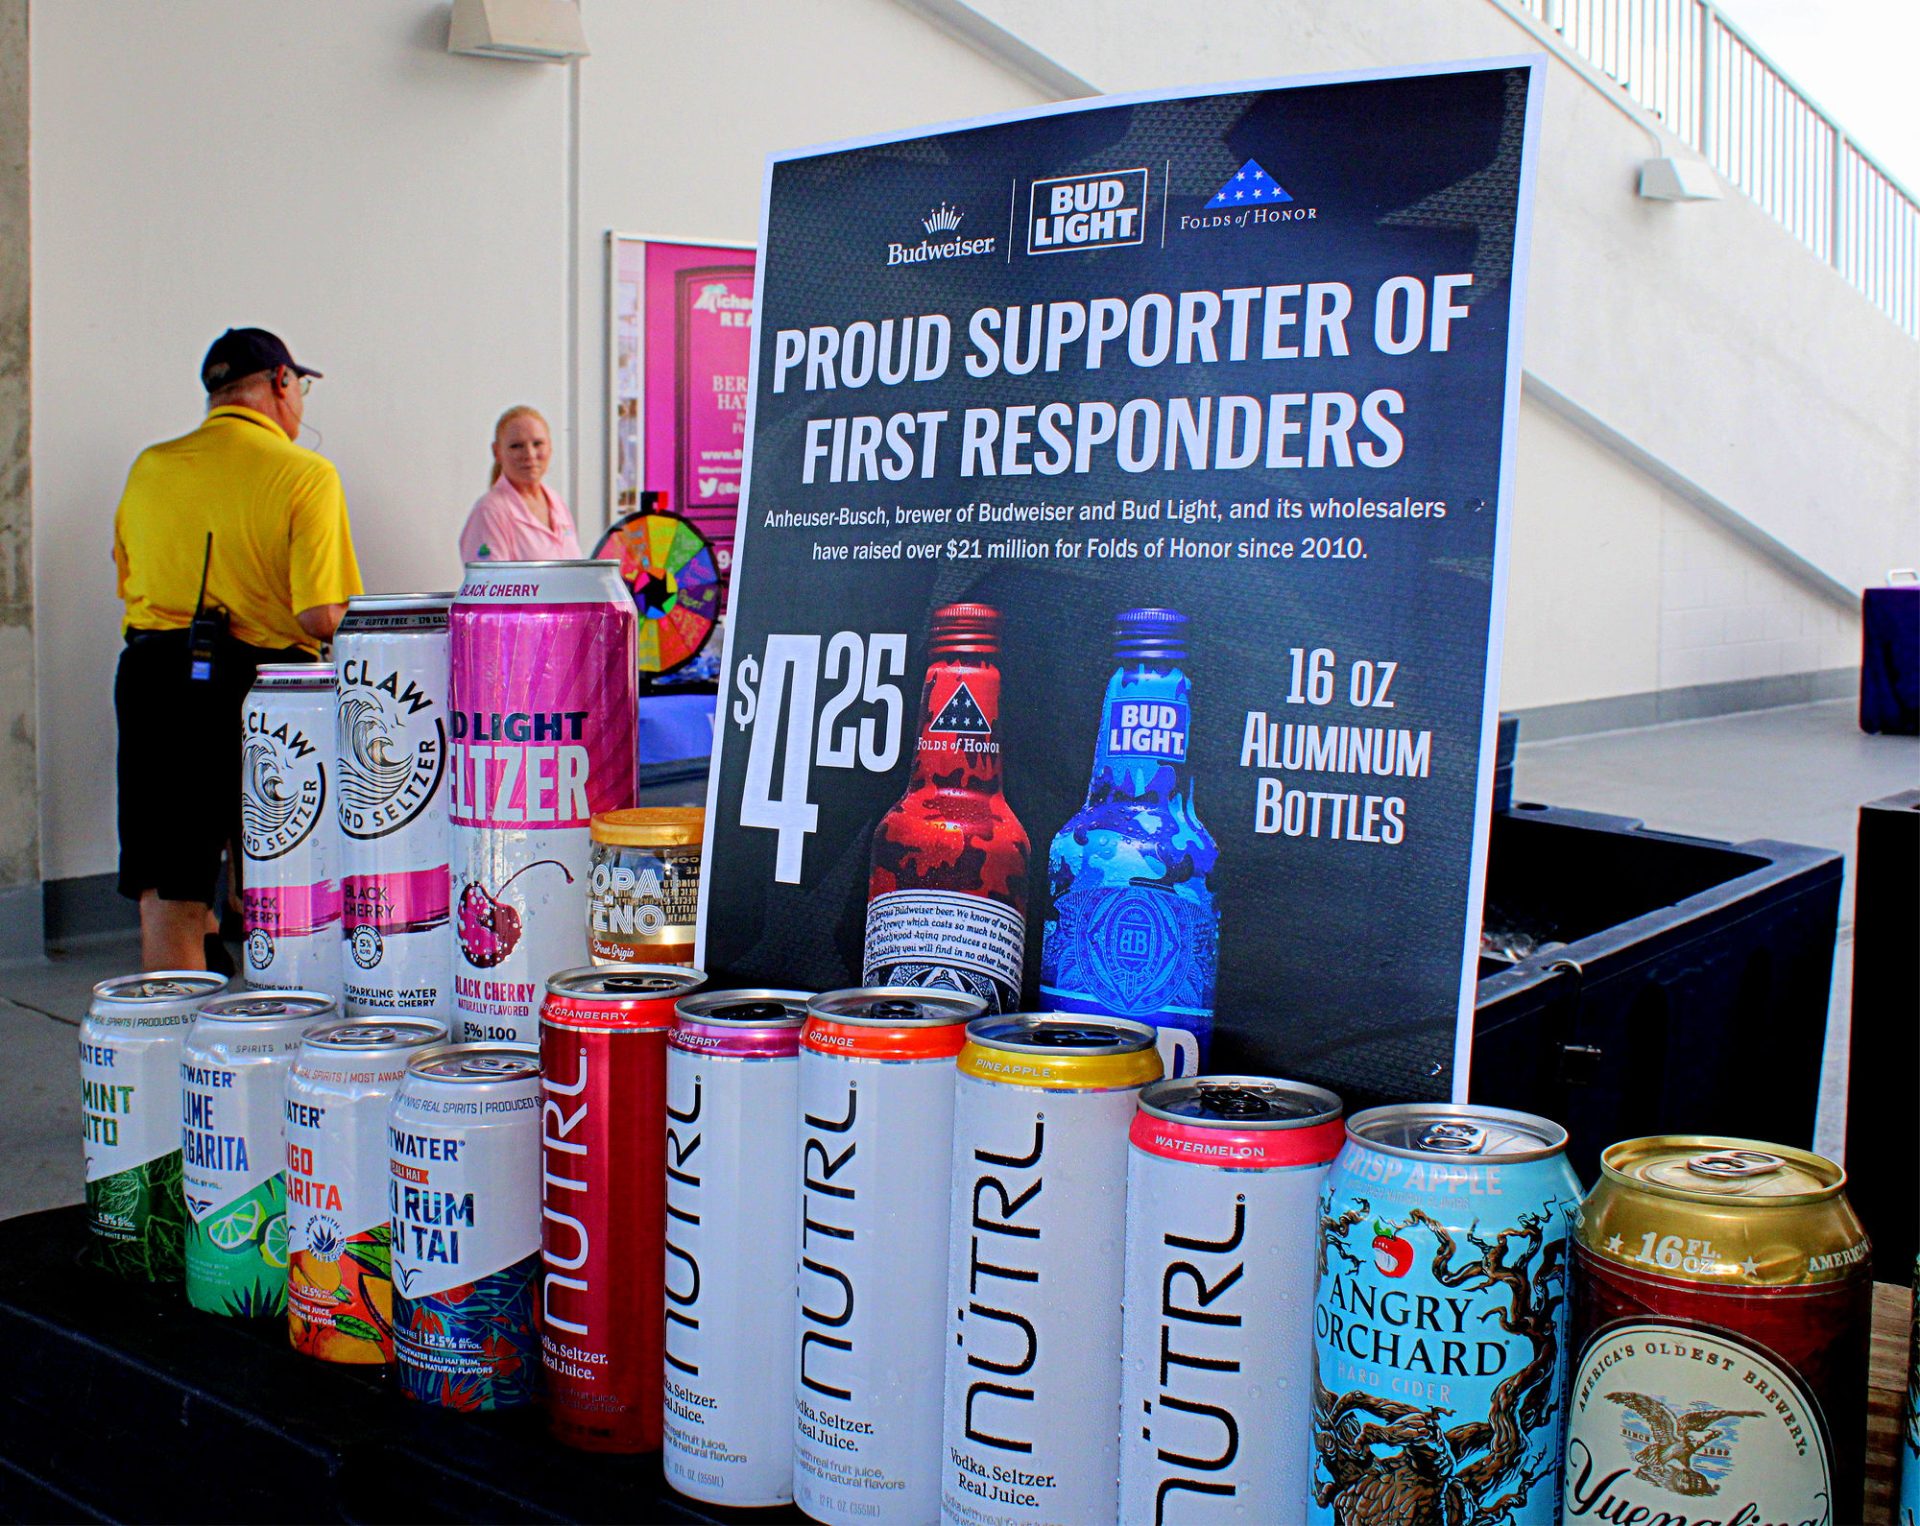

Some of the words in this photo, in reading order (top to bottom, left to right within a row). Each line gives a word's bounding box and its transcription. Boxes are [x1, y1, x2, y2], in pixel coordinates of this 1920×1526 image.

[1050, 180, 1124, 215] BUD
[1034, 208, 1137, 247] LIGHT
[1180, 214, 1231, 230] FOLDS
[1235, 210, 1249, 227] of
[1253, 207, 1318, 224] HONOR
[886, 236, 995, 266] Budweiser
[773, 314, 951, 394] PROUD
[965, 282, 1352, 379] SUPPORTER
[1374, 273, 1473, 355] OF
[802, 411, 948, 484] FIRST
[960, 389, 1405, 478] RESPONDERS
[764, 506, 890, 528] Anheuser-Busch,
[895, 505, 952, 524] brewer
[956, 503, 976, 523] of
[979, 501, 1073, 522] Budweiser
[1079, 500, 1115, 521] and
[1122, 500, 1160, 520] Bud
[1167, 499, 1223, 524] Light,
[1229, 498, 1269, 519] and
[1276, 497, 1303, 519] its
[1309, 497, 1447, 519] wholesalers
[812, 542, 848, 560] have
[853, 541, 901, 560] raised
[906, 543, 942, 559] over
[946, 539, 983, 560] $21
[987, 539, 1050, 558] million
[1054, 538, 1081, 558] for
[1087, 538, 1138, 558] Folds
[1143, 537, 1165, 558] of
[1170, 537, 1232, 558] Honor
[1237, 537, 1294, 558] since
[1300, 537, 1368, 559] 2010.
[490, 584, 539, 597] CHERRY
[344, 659, 433, 715] CLAW
[1286, 648, 1335, 706] 16
[474, 711, 589, 742] LIGHT
[1121, 704, 1177, 729] BUD
[249, 711, 316, 759] CLAW
[950, 738, 962, 754] of
[1110, 728, 1185, 755] LIGHT
[373, 740, 436, 827] SELTZER
[268, 780, 317, 850] SELTZER
[345, 885, 388, 901] BLACK
[344, 902, 395, 919] CHERRY
[894, 905, 934, 917] Budweiser
[935, 906, 955, 918] beer.
[957, 908, 969, 920] We
[970, 911, 991, 925] know
[906, 916, 929, 929] which
[932, 919, 953, 930] costs
[955, 922, 965, 931] so
[967, 924, 988, 938] much
[360, 938, 372, 948] 5%
[941, 934, 981, 949] produces
[902, 945, 916, 955] you
[918, 944, 934, 954] will
[935, 943, 953, 955] find
[964, 951, 976, 961] no
[977, 953, 997, 967] other
[349, 984, 394, 998] SPARKLING
[398, 988, 437, 999] WATER
[455, 975, 481, 999] BLACK
[484, 981, 536, 1003] CHERRY
[359, 997, 368, 1006] OF
[369, 997, 395, 1008] BLACK
[398, 998, 435, 1007] CHERRY
[489, 1003, 529, 1017] FLAVORED
[554, 1006, 629, 1021] CRANBERRY
[137, 1014, 180, 1027] PRODUCED
[463, 1022, 483, 1038] 5%
[488, 1025, 516, 1041] 100
[235, 1045, 274, 1053] SPIRITS
[678, 1032, 721, 1047] CHERRY
[809, 1030, 855, 1048] ORANGE
[312, 1070, 342, 1084] SPIRITS
[351, 1072, 376, 1084] MOST
[975, 1056, 1052, 1078] PINEAPPLE
[82, 1079, 135, 1114] MINT
[421, 1100, 440, 1113] REAL
[442, 1102, 477, 1115] SPIRITS
[486, 1097, 534, 1113] PRODUCED
[183, 1088, 214, 1131] LIME
[285, 1099, 321, 1129] ATER
[1155, 1135, 1265, 1158] WATERMELON
[1342, 1148, 1400, 1186] CRISP
[1403, 1162, 1503, 1196] APPLE
[405, 1185, 474, 1228] RUM
[412, 1223, 459, 1265] TAI
[1635, 1231, 1684, 1269] 16
[1687, 1238, 1722, 1259] FL.
[1329, 1273, 1473, 1334] ANGRY
[424, 1333, 456, 1349] 12.5%
[1316, 1303, 1507, 1377] ORCHARD
[560, 1344, 609, 1365] Seltzer.
[458, 1366, 493, 1375] FLAVORS
[558, 1358, 596, 1380] Juice.
[1338, 1360, 1380, 1387] HARD
[1392, 1377, 1452, 1402] CIDER
[674, 1384, 718, 1409] Seltzer.
[1578, 1344, 1636, 1412] AMERICA'S
[1645, 1342, 1735, 1371] OLDEST
[1743, 1370, 1809, 1450] BREWERY
[673, 1400, 705, 1425] Juice.
[819, 1410, 874, 1434] Seltzer.
[702, 1438, 728, 1453] juice,
[817, 1429, 859, 1451] Juice.
[678, 1441, 709, 1459] natural
[709, 1449, 748, 1463] flavors
[829, 1459, 852, 1474] fruit
[855, 1464, 884, 1480] juice,
[950, 1446, 991, 1479] Vodka.
[992, 1465, 1057, 1488] Seltzer.
[825, 1471, 861, 1488] natural
[864, 1477, 906, 1490] flavors
[958, 1471, 987, 1498] Real
[988, 1485, 1040, 1508] Juice.
